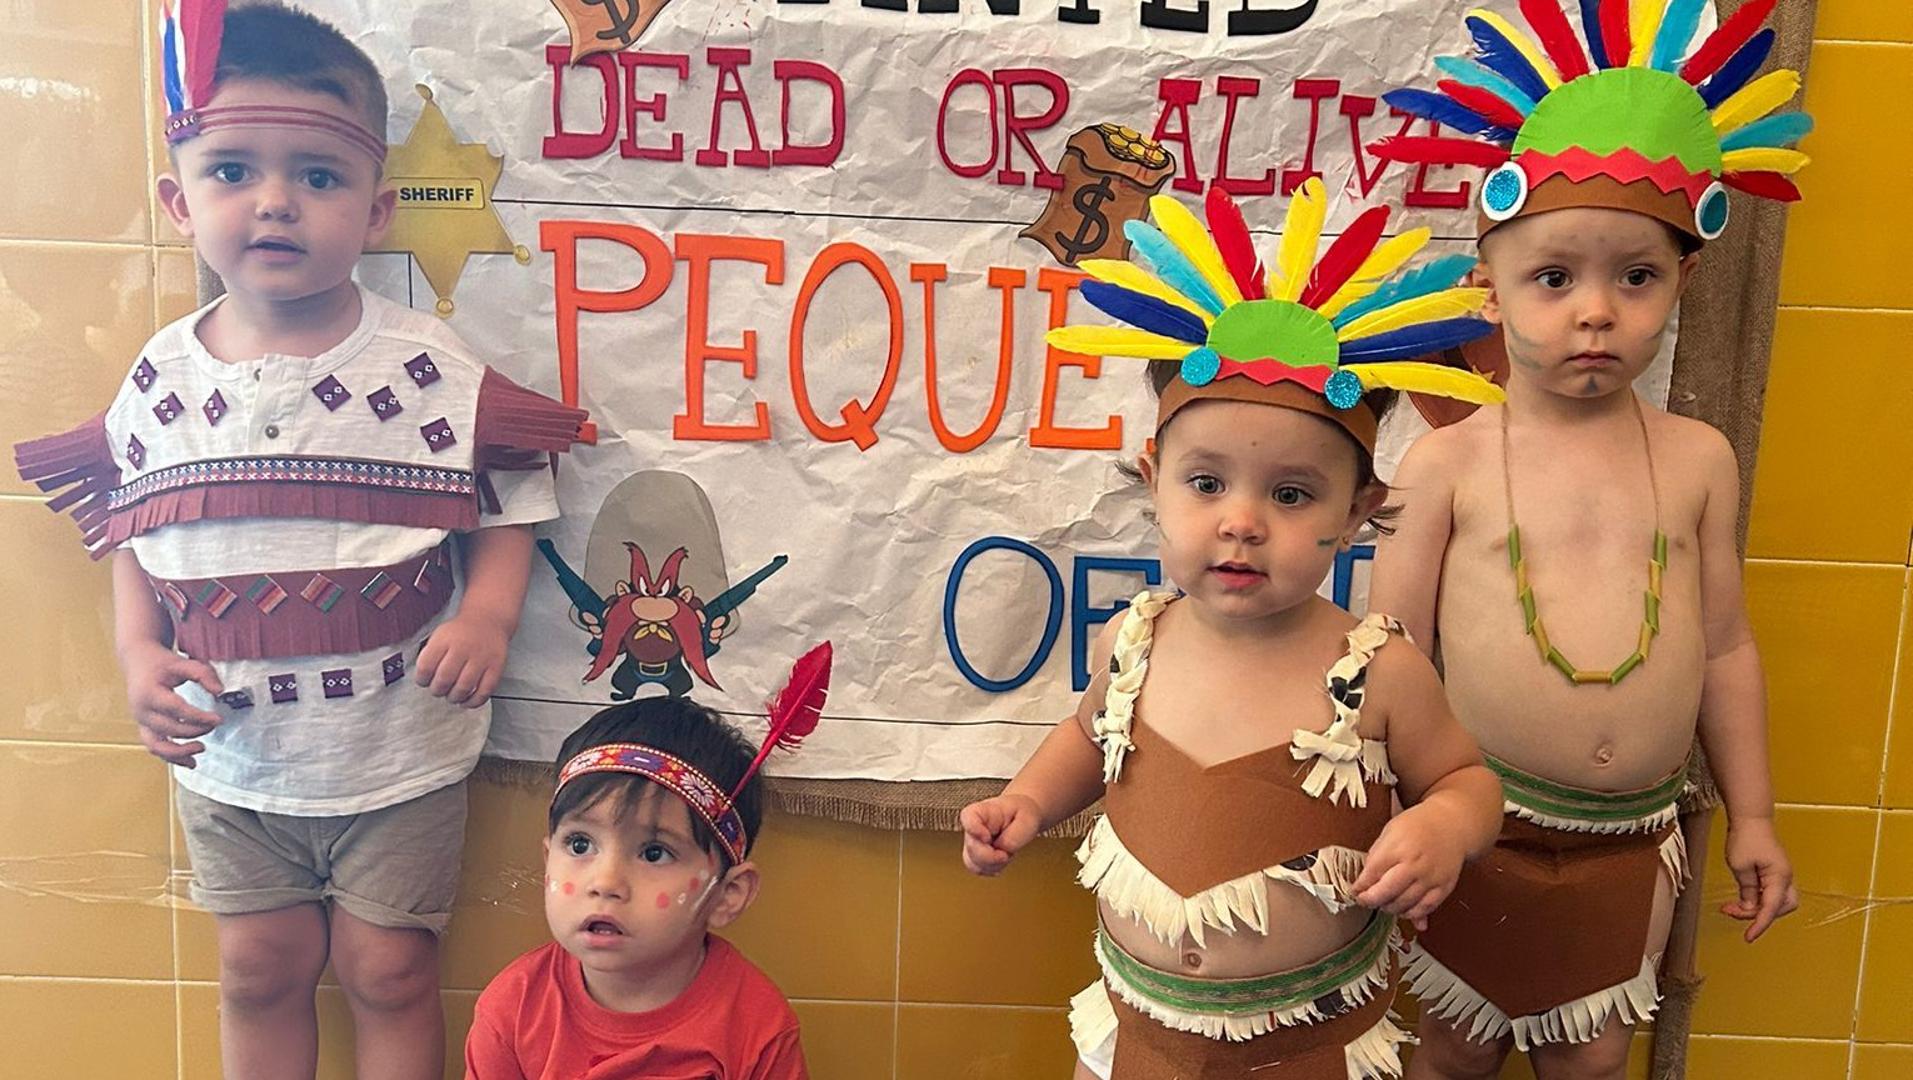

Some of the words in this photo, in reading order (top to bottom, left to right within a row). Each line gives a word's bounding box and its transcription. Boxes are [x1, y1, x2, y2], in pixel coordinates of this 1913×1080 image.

[542, 45, 846, 168] DEAD
[937, 68, 1067, 190] OR
[400, 187, 474, 201] SHERIFF
[540, 220, 1156, 453] PEQUE
